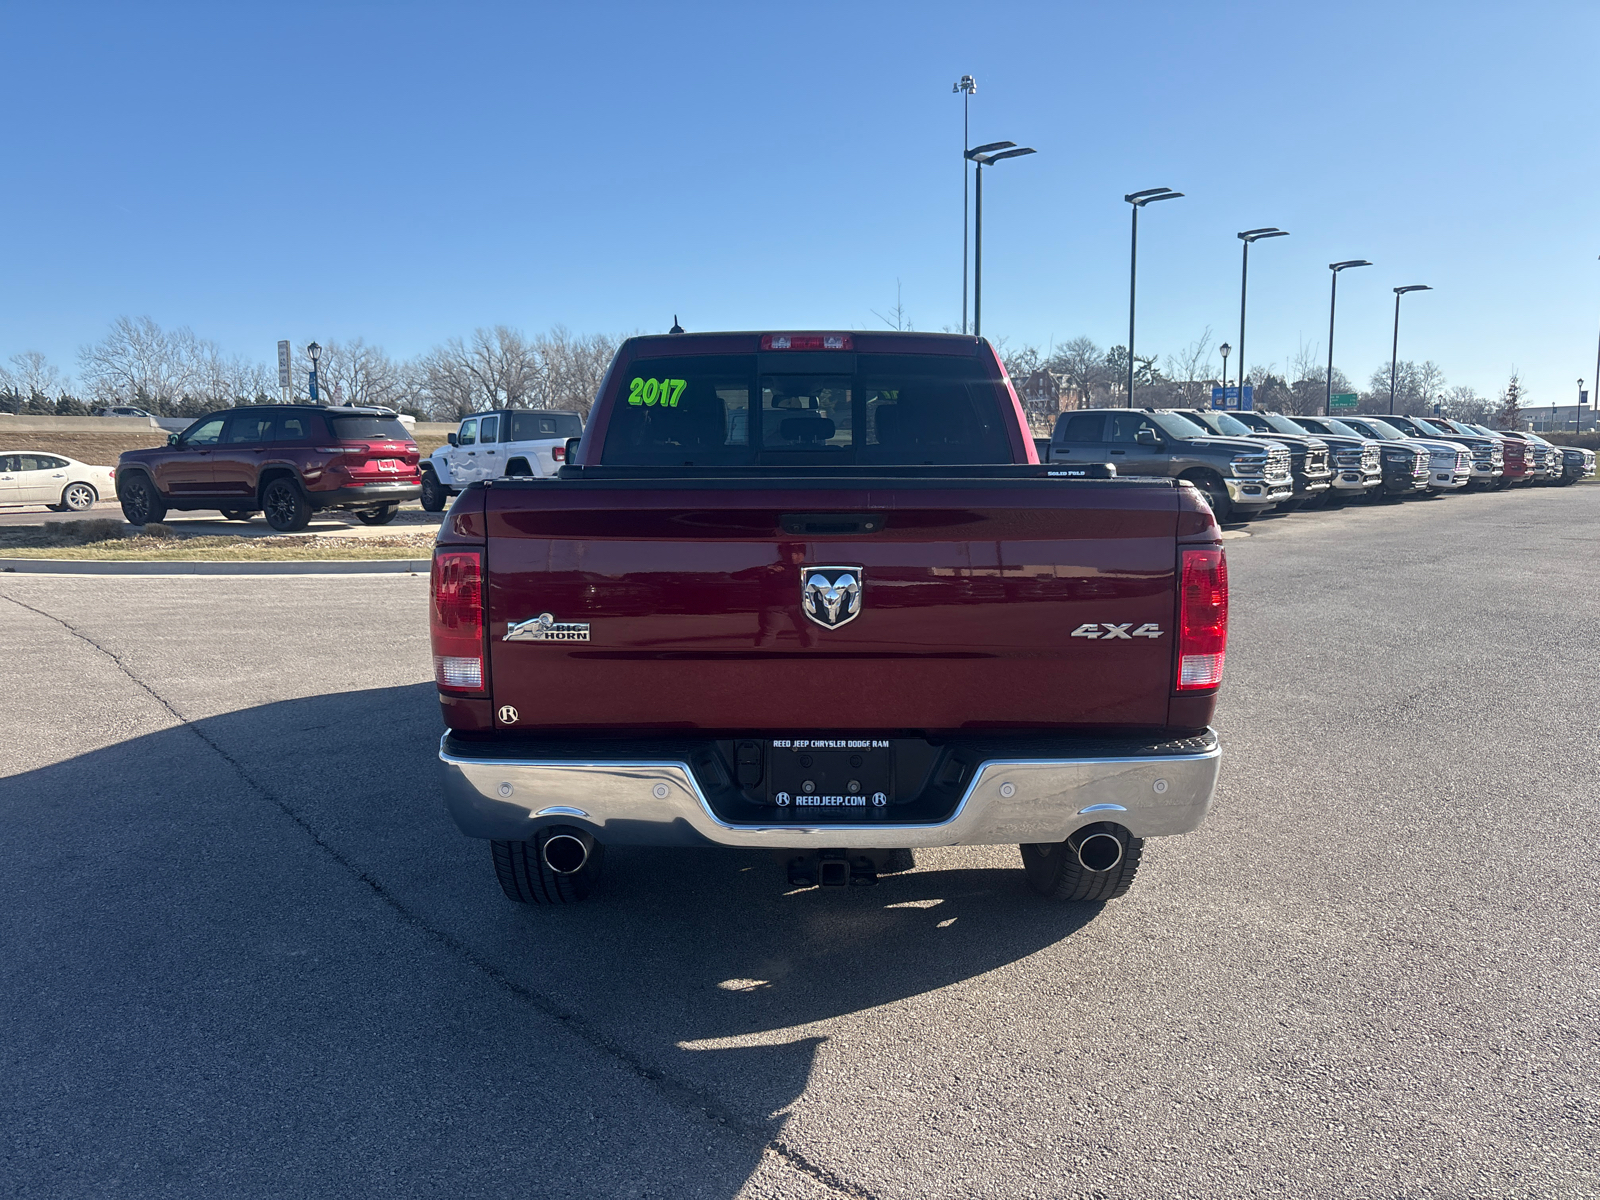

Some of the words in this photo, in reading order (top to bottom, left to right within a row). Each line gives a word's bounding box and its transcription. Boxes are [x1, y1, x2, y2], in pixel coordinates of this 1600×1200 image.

[628, 377, 687, 407] 2017
[1071, 623, 1164, 639] 4X4
[773, 740, 791, 748] REED
[793, 740, 809, 748] JEEP
[811, 740, 846, 748] CHRYSLER
[848, 740, 870, 748] DODGE
[872, 740, 889, 748] RAM
[796, 796, 866, 806] REEDJEEP.COM
